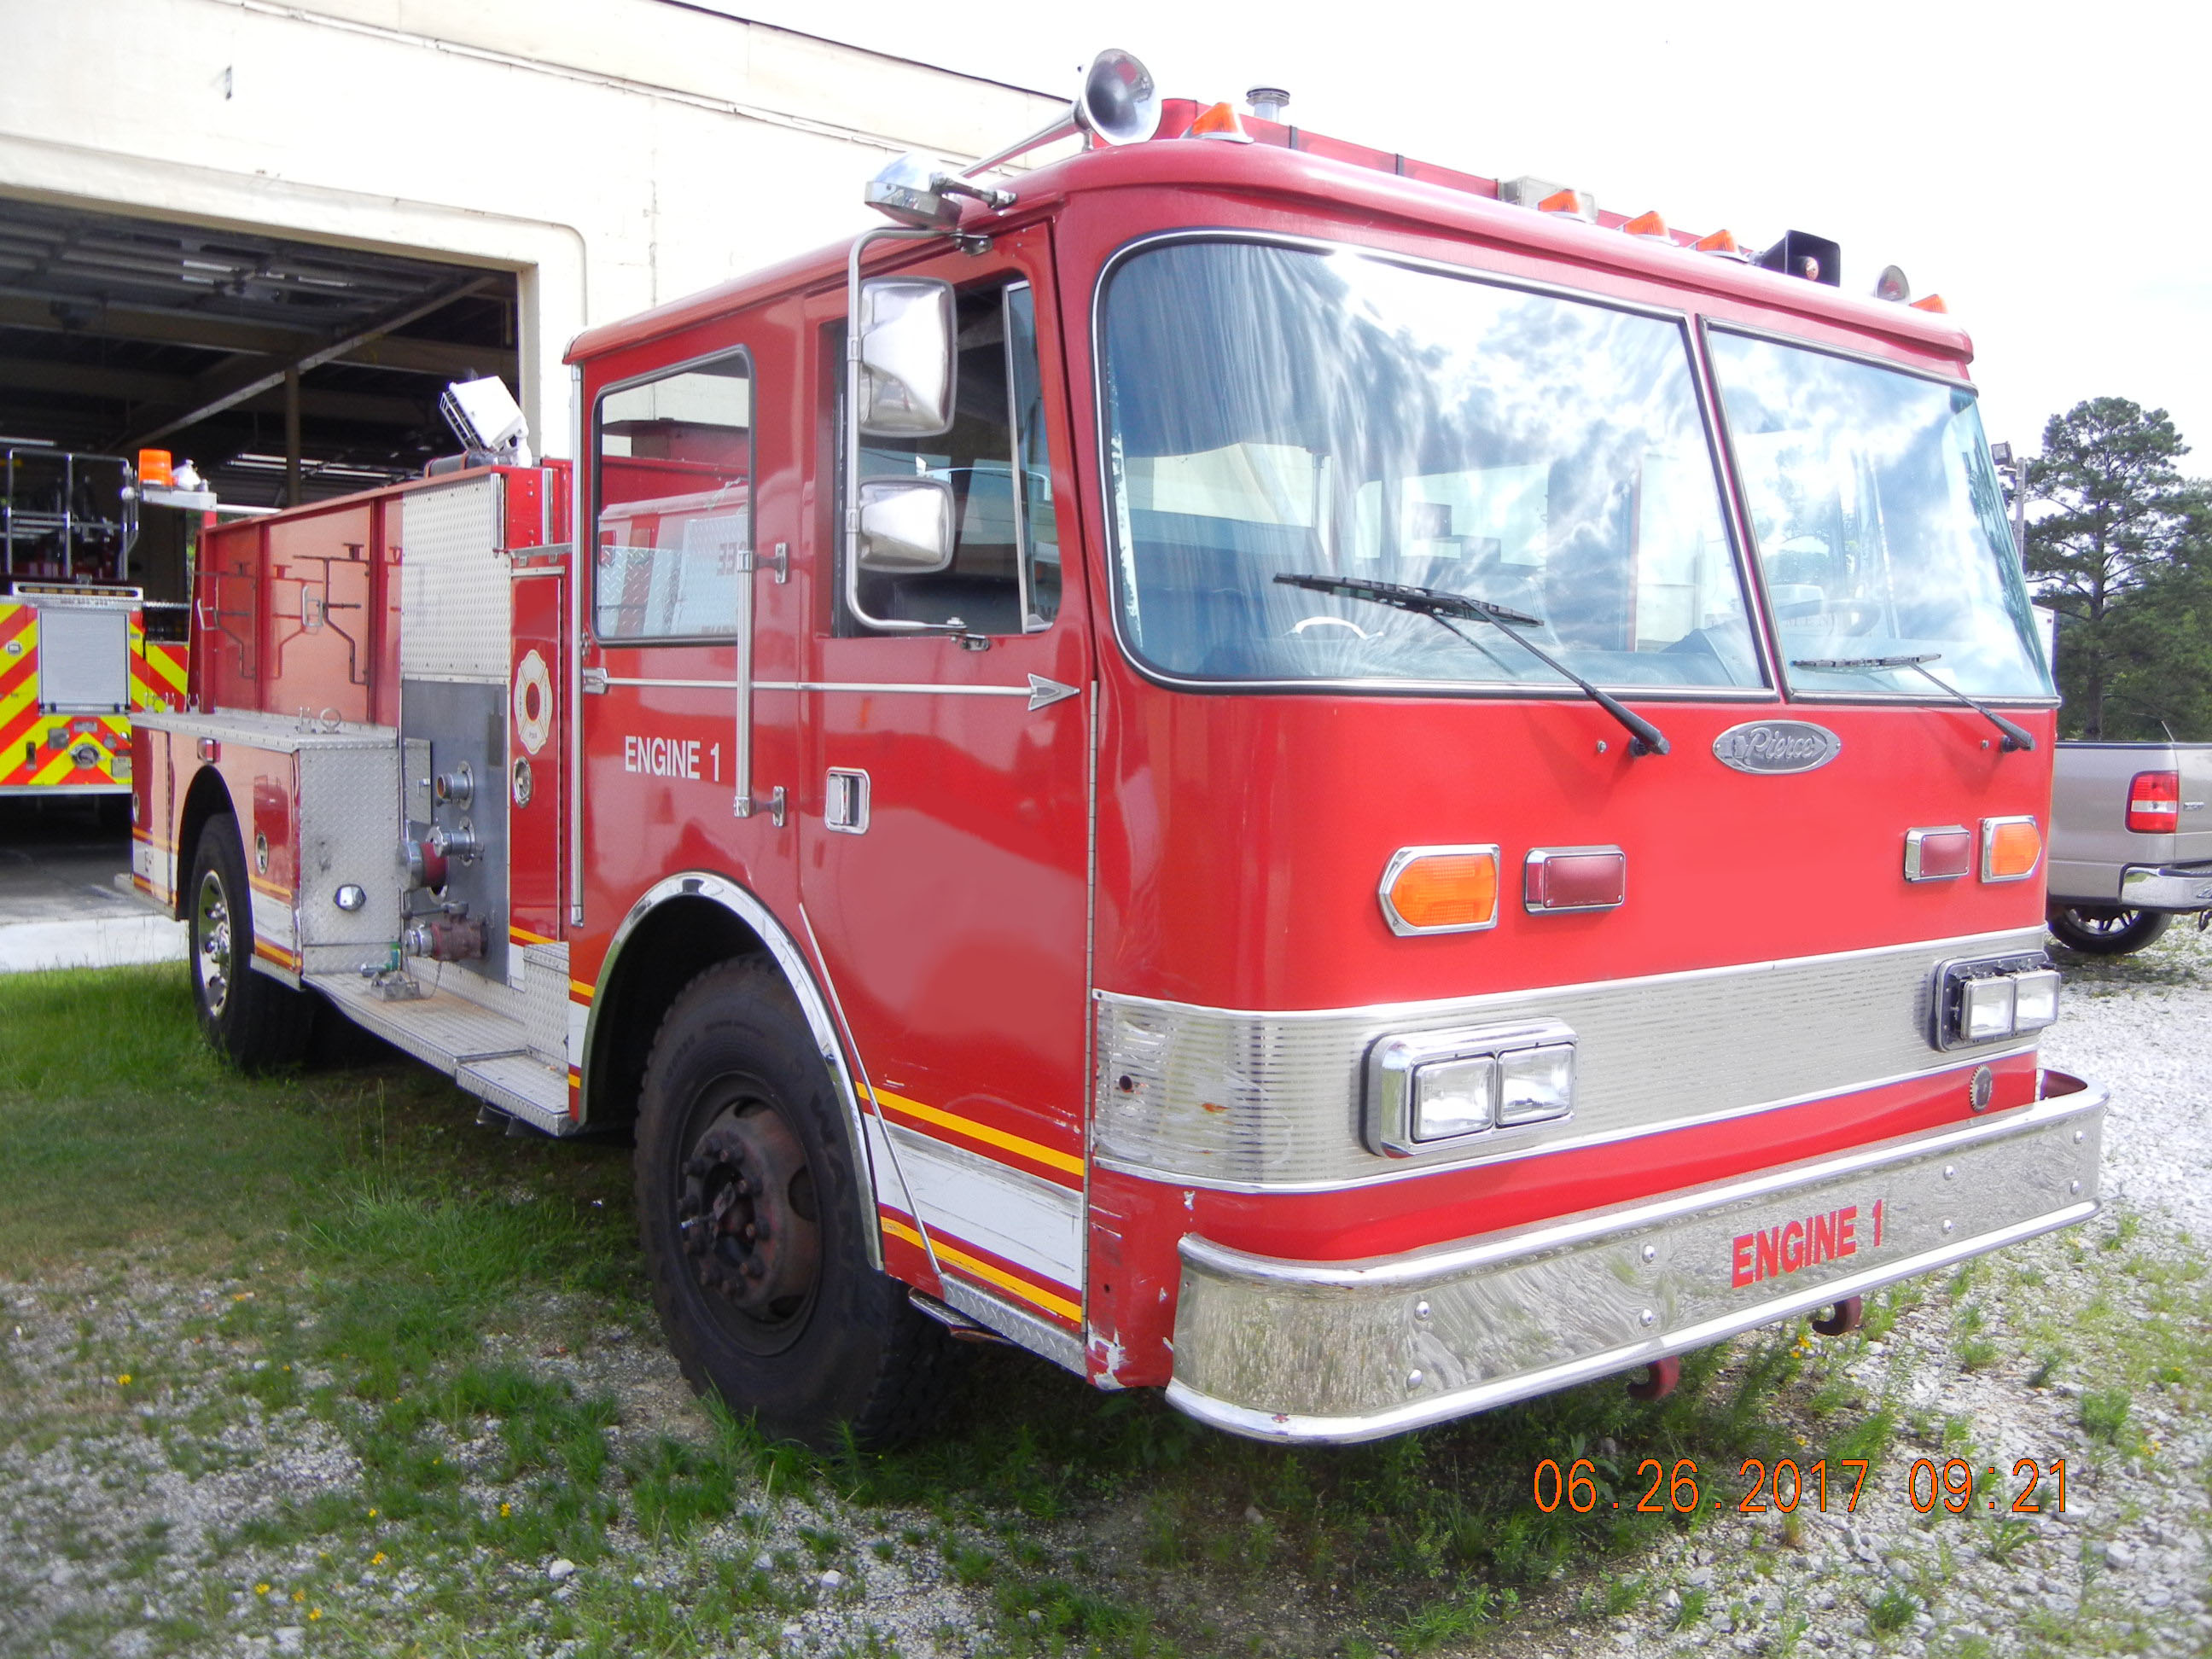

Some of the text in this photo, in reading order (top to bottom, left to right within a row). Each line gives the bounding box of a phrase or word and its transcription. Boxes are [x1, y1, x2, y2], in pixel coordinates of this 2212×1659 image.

[625, 735, 720, 783] ENGINE 1
[1743, 727, 1814, 765] Pierce
[1732, 1198, 1883, 1289] ENGINE 1
